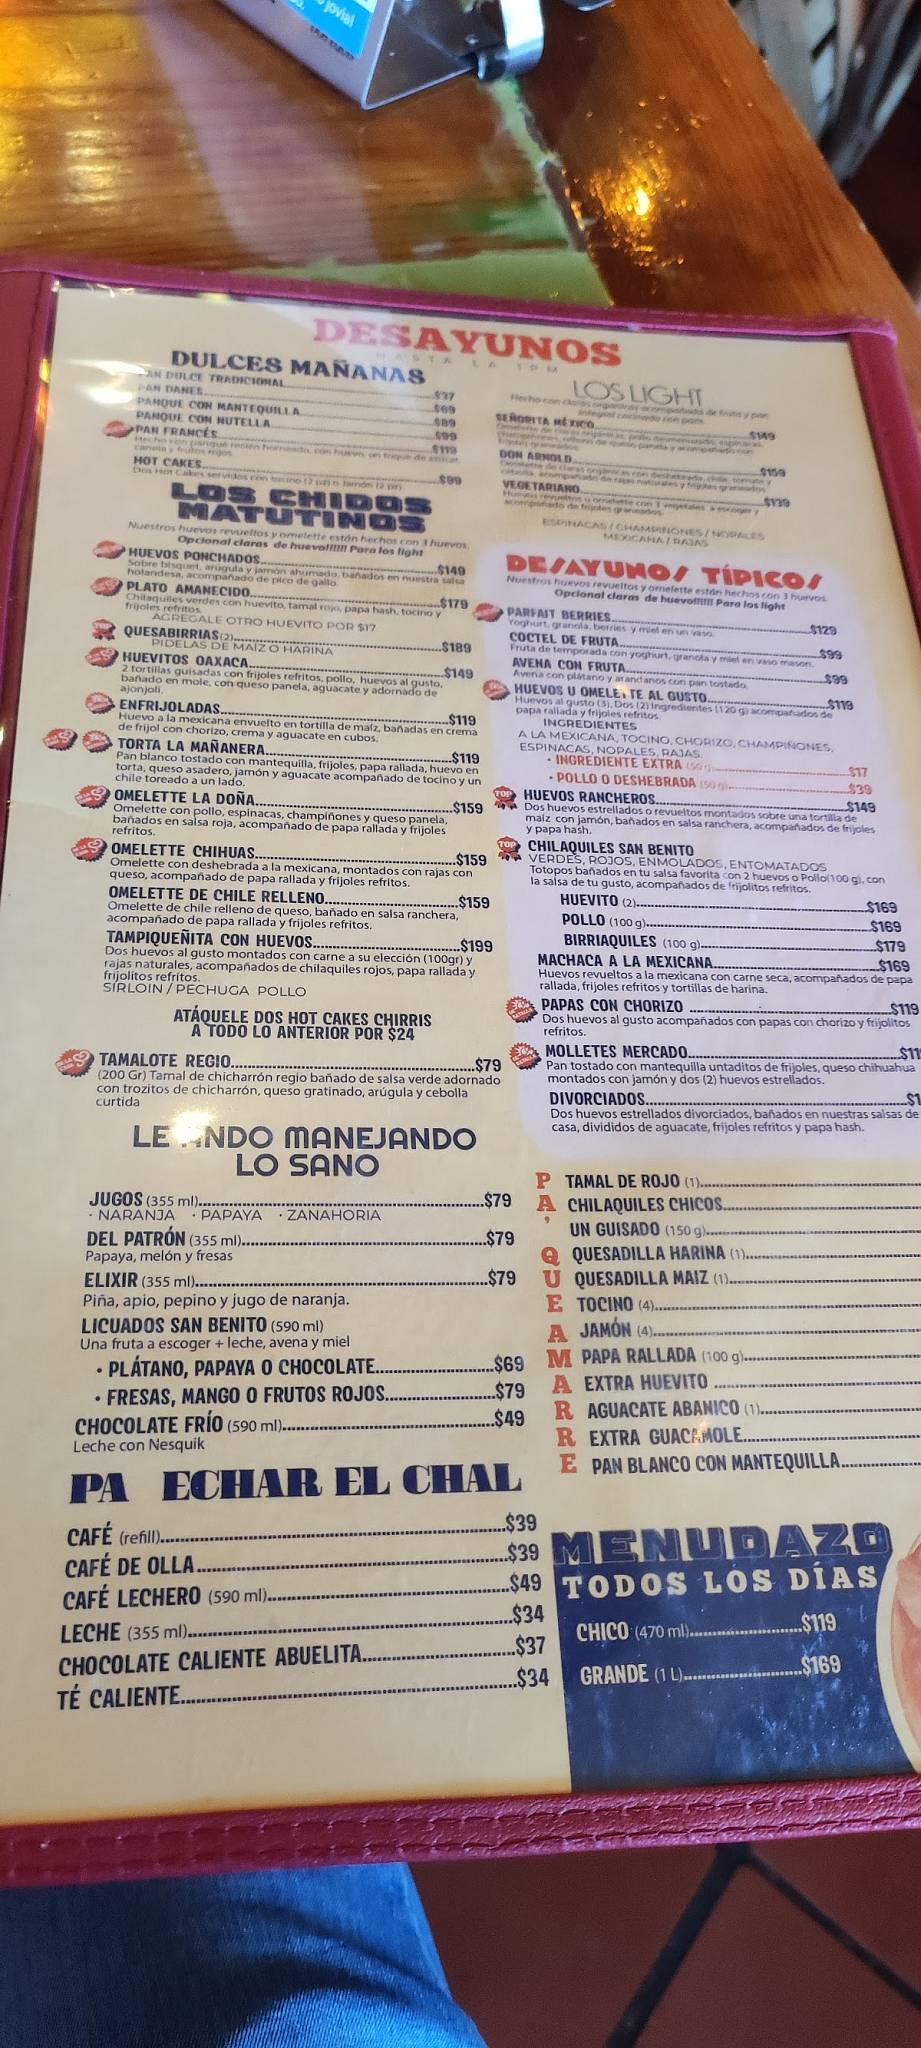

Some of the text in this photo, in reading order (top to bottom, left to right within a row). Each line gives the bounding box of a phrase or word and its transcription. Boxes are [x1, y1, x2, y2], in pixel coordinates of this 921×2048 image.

[313, 318, 622, 367] DESAYUNOS
[172, 350, 425, 384] DULCES MAÑANAS
[573, 380, 703, 406] LOS LIGHT
[171, 482, 432, 516] LOS CHIDOS
[502, 480, 580, 494] VEGETARIANO
[178, 502, 427, 533] MATUTINOS
[129, 547, 465, 576] HUEVOS PONCHADOS $149
[506, 554, 823, 591] DESAYUNOS TÍPICOS
[127, 581, 468, 610] PLATO AMANECIDO $179
[152, 613, 376, 632] AGREGALE OTRO HUEVITO POR $17
[510, 632, 842, 660] COCTEL DE FRUTA $99
[120, 699, 476, 726] ENFRIJOLADAS $119
[118, 722, 132, 731] de
[136, 723, 160, 734] frijol
[186, 726, 229, 736] chorizo,
[268, 731, 274, 739] y
[276, 732, 325, 740] aguacate
[344, 733, 378, 742] cubos.
[118, 738, 480, 765] TORTA LA MAÑANERA $119
[524, 789, 876, 813] HUEVOS RANCHEROS $149
[528, 840, 694, 856] CHILAQUILES SAN BENITO
[110, 871, 410, 888] queso, acompañado de papa rallada y frijoles refritos.
[109, 886, 490, 910] OMELETTE DE CHILE RELLENO $159
[107, 930, 493, 954] TAMPIQUEÑITA CON HUEVOS $199
[538, 954, 910, 973] MACHACA A LA MEXICANA $169
[174, 1009, 431, 1029] ATÁQUELE DOS HOT CAKES CHIRRIS
[542, 998, 919, 1016] PAPAS CON CHORIZO $119
[100, 1053, 178, 1067] TAMALOTE
[186, 1054, 233, 1068] REGIO
[475, 1058, 501, 1073] $79
[546, 1044, 690, 1058] MOLLETES MERCADO
[550, 1092, 647, 1106] DIVORCIADOS
[132, 1125, 170, 1148] LE
[285, 1127, 477, 1151] MANEJANDO
[552, 1122, 864, 1134] casa, divididos de aguacate, frijoles refritos y papa hash.
[236, 1153, 380, 1177] LO SANO
[99, 1209, 381, 1221] NARANJA PAPAYA ZANAHORIA
[568, 1197, 724, 1215] CHILAQUILES CHICOS
[86, 1250, 233, 1264] Papaya, melón y fresas
[84, 1293, 349, 1310] Piña, apio, pepino y jugo de naranja.
[109, 1356, 524, 1379] PLÁTANO, PAPAYA O CHOCOLATE $69
[584, 1374, 708, 1392] EXTRA HUEVITO
[74, 1437, 205, 1454] Leche con Nesquik
[590, 1429, 641, 1447] EXTRA
[592, 1452, 840, 1475] PAN BLANCO CON MANTEQUILLA
[162, 1468, 322, 1501] ECHAR
[335, 1466, 390, 1497] EL
[402, 1462, 522, 1495] CHAL
[552, 1522, 894, 1565] MENUDAZO
[65, 1544, 539, 1578] CAFÉ DE OLLA $39
[562, 1562, 879, 1600] TODOS LOS DÍAS
[59, 1638, 546, 1677] CHOCOLATE CALIENTE ABUELITA $37
[57, 1670, 549, 1710] TÉ CALIENTE $34
